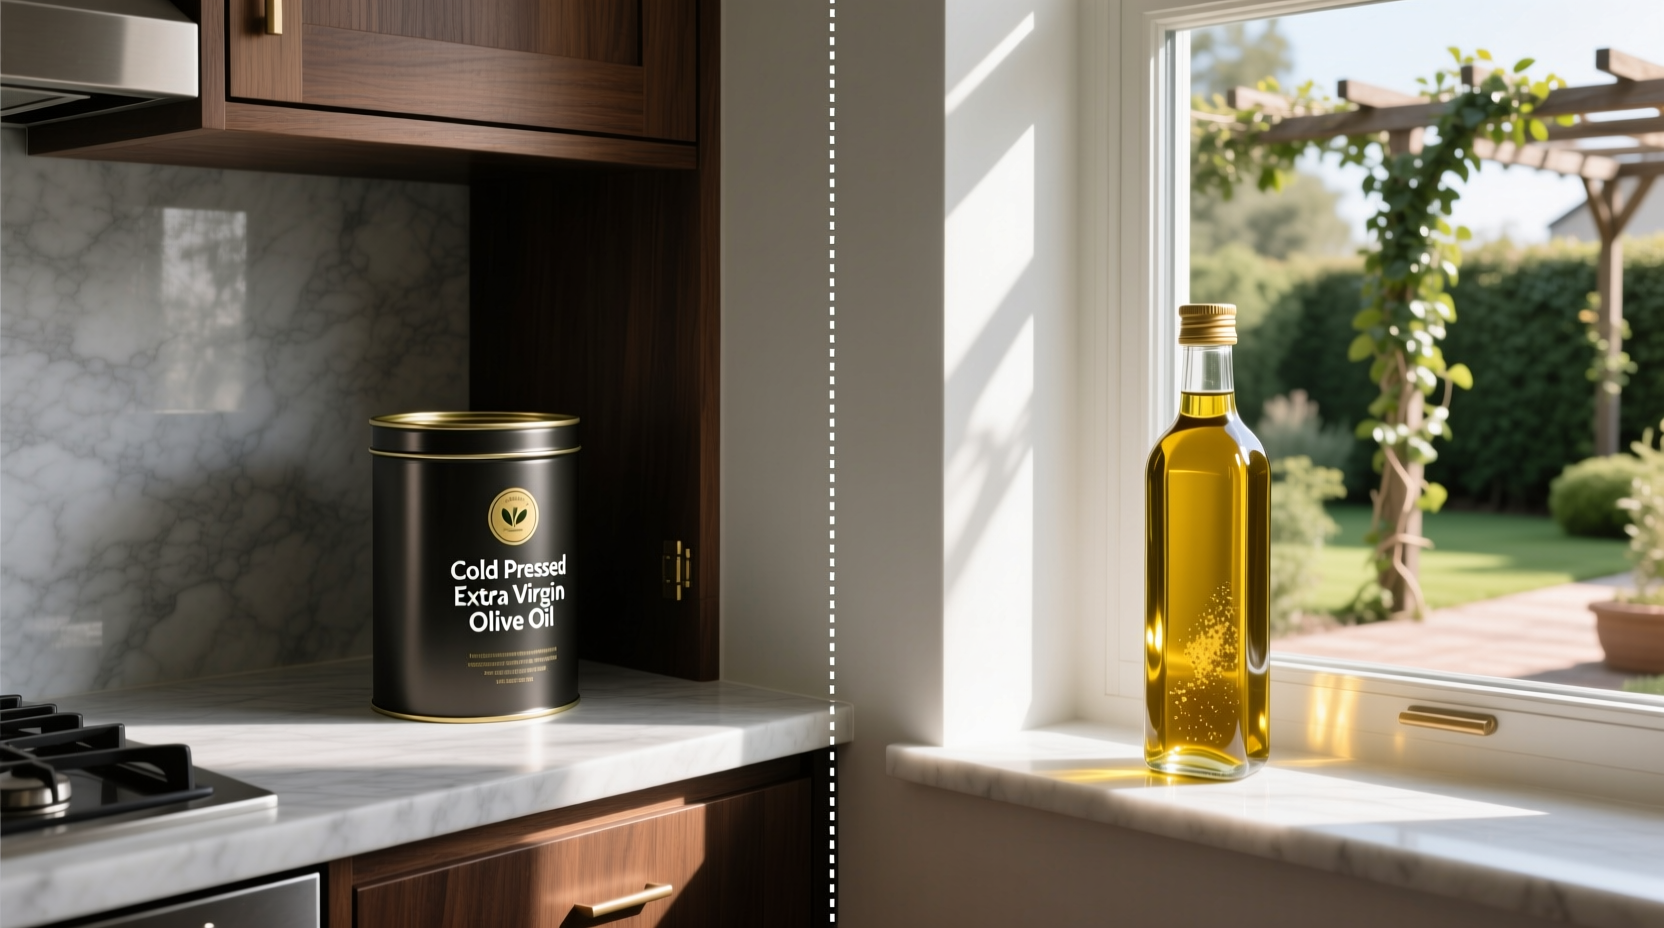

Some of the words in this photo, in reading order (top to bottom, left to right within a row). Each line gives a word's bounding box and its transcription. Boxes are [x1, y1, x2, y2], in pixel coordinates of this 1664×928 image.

[450, 559, 499, 580] Cold
[504, 554, 567, 580] Pressed
[454, 586, 509, 607] Extra
[512, 582, 565, 608] Virgin
[469, 610, 525, 633] Olive
[528, 605, 555, 629] Oil
